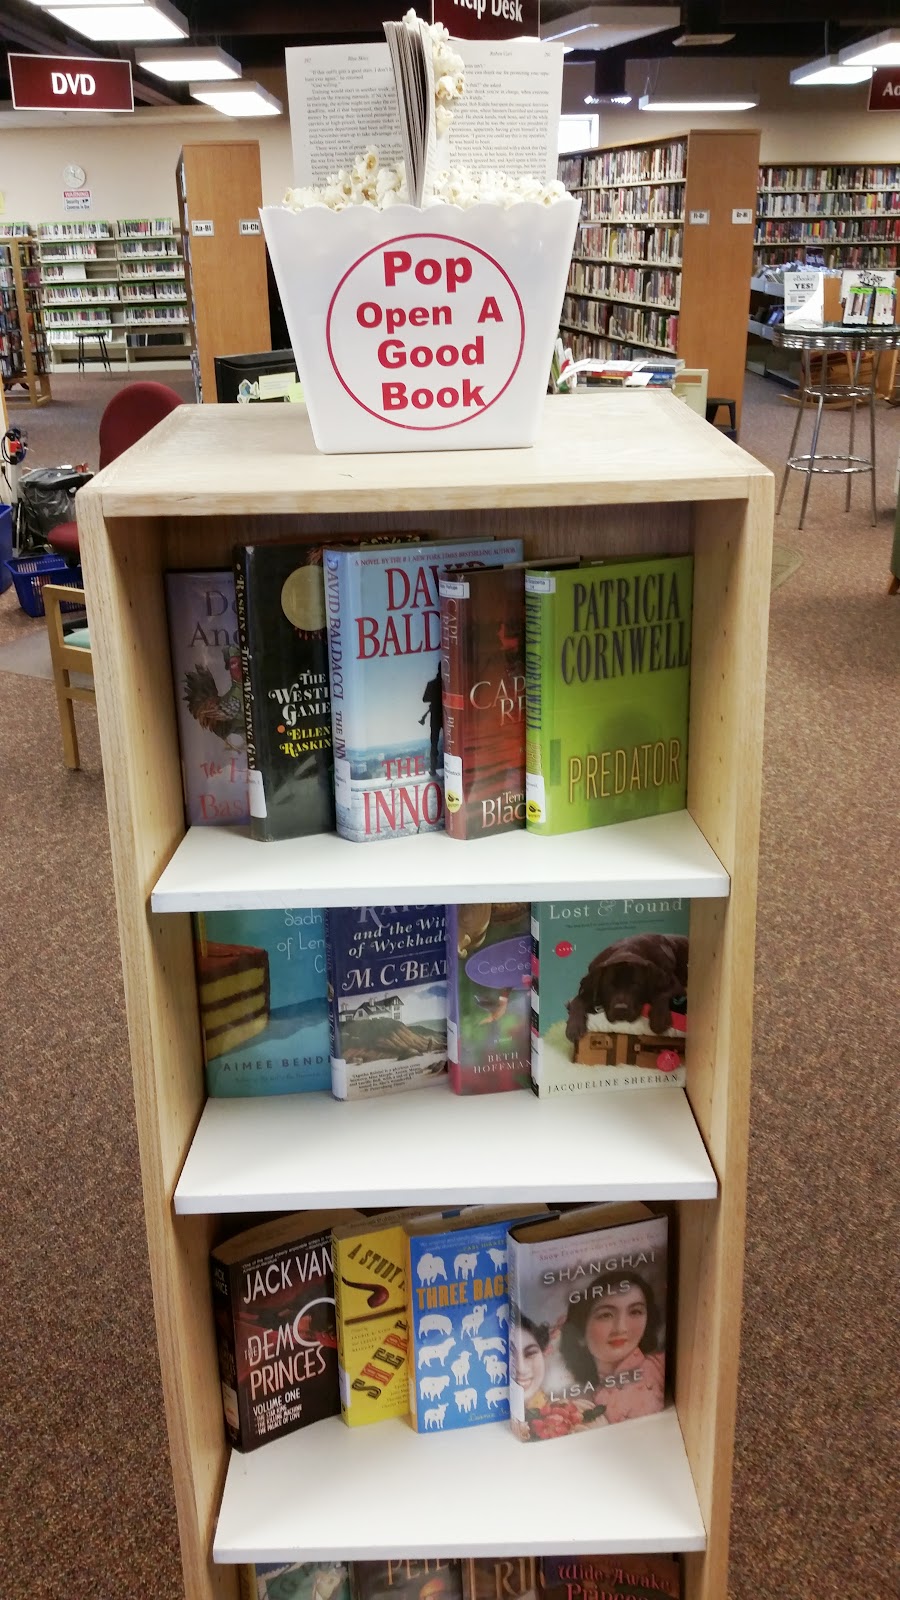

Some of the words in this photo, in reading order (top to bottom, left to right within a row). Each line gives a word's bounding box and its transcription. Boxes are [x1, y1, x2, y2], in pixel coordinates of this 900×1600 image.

[453, 0, 486, 20] elp
[491, 0, 523, 22] Desk
[51, 72, 96, 96] DVD
[383, 250, 473, 293] Pop
[356, 301, 453, 334] Open
[477, 296, 504, 324] A
[377, 336, 485, 370] Good
[381, 378, 487, 411] Book
[327, 557, 342, 614] DAVID
[573, 572, 681, 633] PATRICIA
[330, 618, 344, 700] BALDACCI
[561, 620, 691, 686] CORNWELL
[300, 669, 327, 686] THE
[526, 651, 542, 730] CORNWELL
[282, 702, 332, 727] GAME
[286, 726, 332, 740] ELLEN
[279, 738, 332, 758] RASKIN
[200, 761, 223, 778] The
[381, 756, 426, 780] THE
[569, 738, 682, 804] PREDATOR
[362, 781, 442, 835] INNO
[550, 904, 590, 920] Lost
[624, 898, 682, 914] Found
[354, 926, 383, 941] and
[390, 922, 413, 936] the
[277, 938, 293, 960] of
[348, 943, 365, 958] of
[342, 967, 374, 991] M.
[380, 964, 398, 986] C.
[478, 958, 532, 975] CeeCee
[224, 1060, 273, 1072] AIMEE
[473, 1060, 532, 1074] HOFFMAN
[488, 1052, 519, 1062] BETH
[548, 1078, 619, 1094] JACQUELINE
[624, 1074, 679, 1086] SHEEHAN
[243, 1259, 293, 1304] JACK
[296, 1246, 334, 1283] VAN
[347, 1243, 362, 1260] A
[358, 1250, 404, 1284] STUDY
[543, 1250, 656, 1285] SHANGHAI
[416, 1281, 468, 1310] THREE
[568, 1280, 632, 1304] GIRLS
[250, 1345, 327, 1400] PRINCES
[550, 1381, 595, 1402] LISA
[604, 1368, 644, 1388] SEE
[253, 1395, 282, 1416] VOLUME
[284, 1388, 301, 1404] ONE
